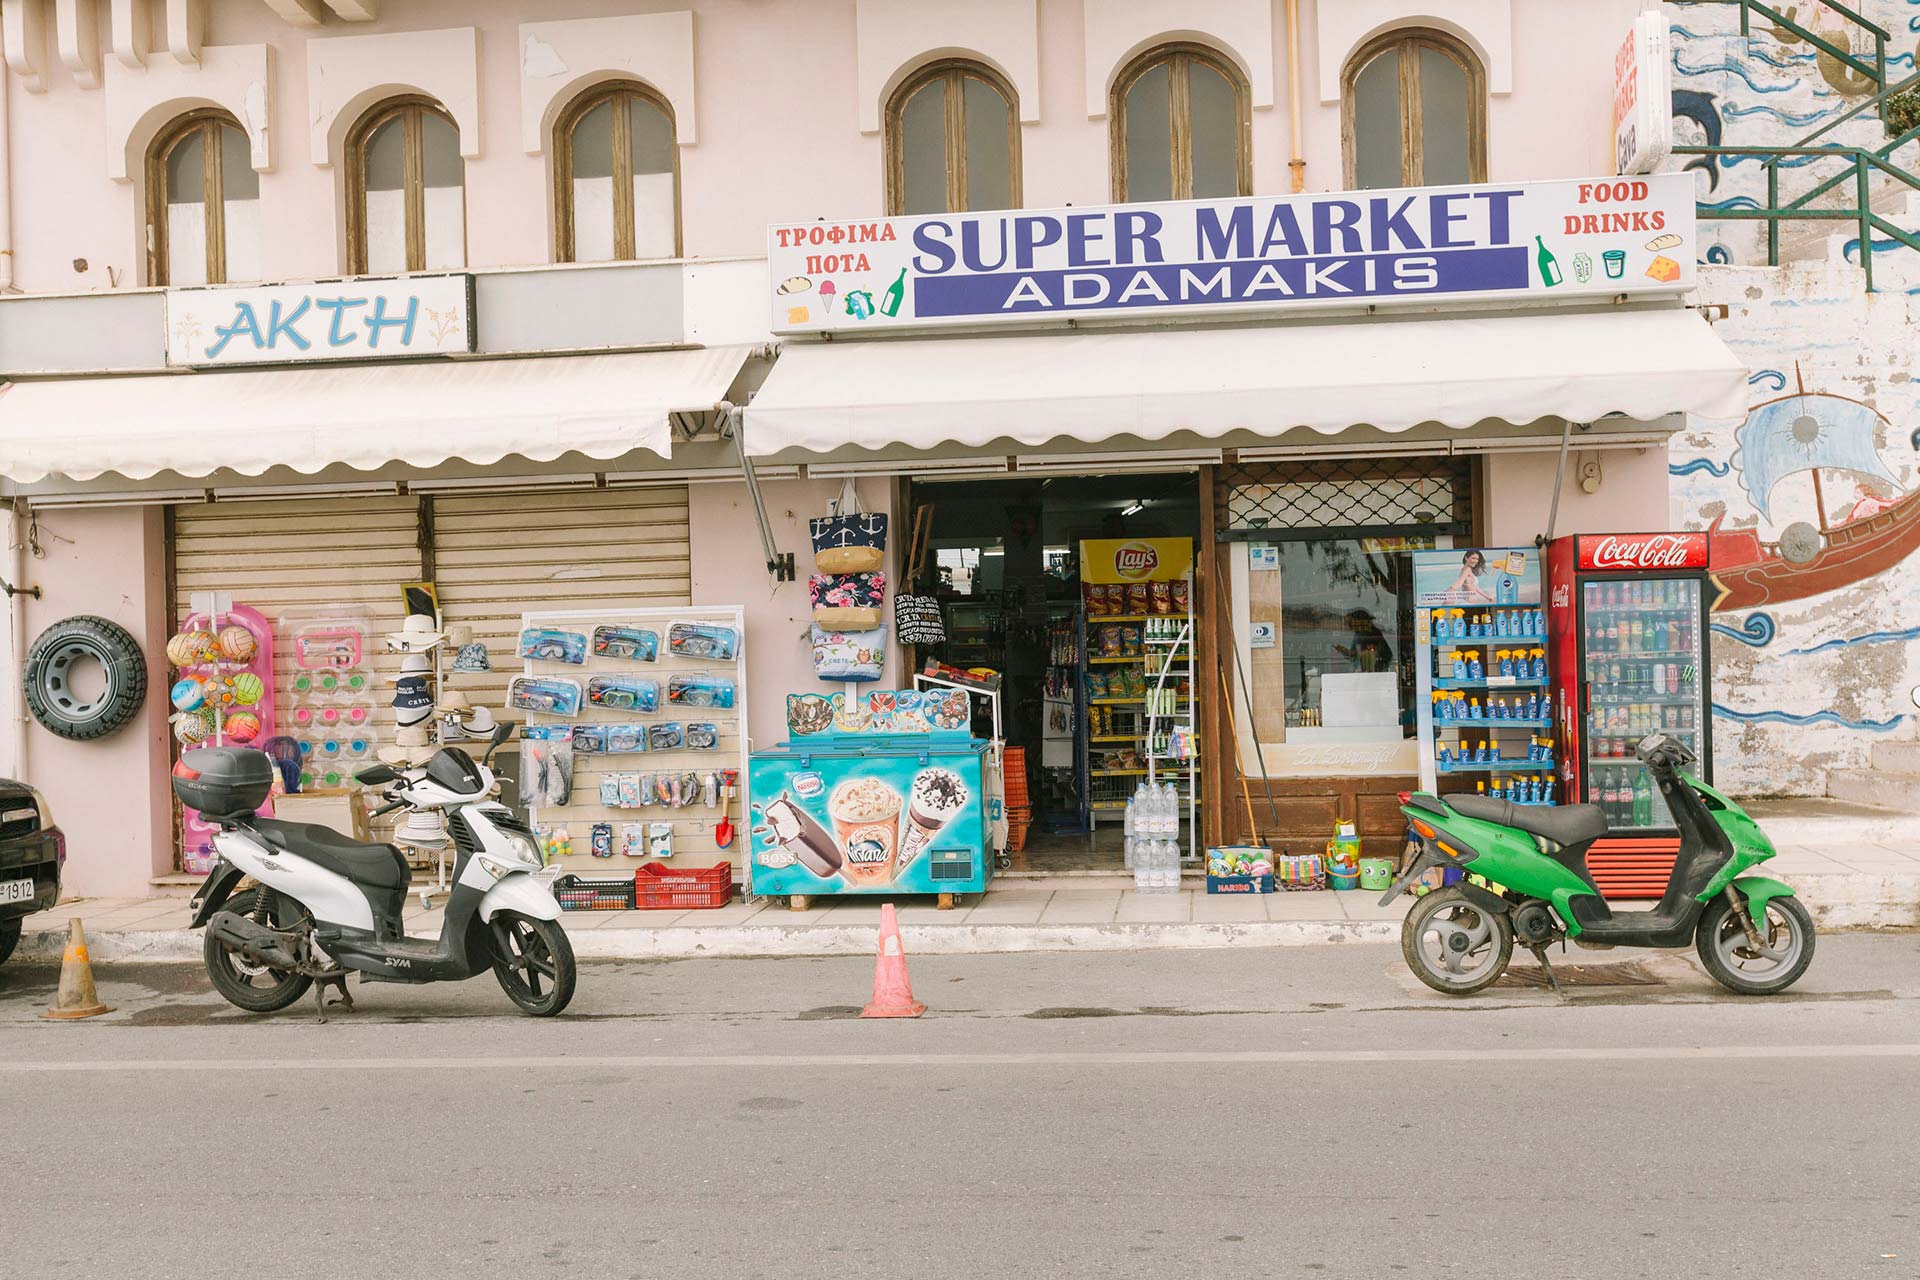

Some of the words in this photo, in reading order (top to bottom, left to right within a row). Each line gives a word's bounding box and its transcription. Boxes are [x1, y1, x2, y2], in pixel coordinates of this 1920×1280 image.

[1577, 181, 1649, 205] FOOD
[776, 222, 897, 248] ΤΡΟΦΙΜΑ
[912, 210, 1164, 274] SUPER
[1196, 189, 1525, 262] MARKET
[1564, 210, 1665, 236] DRINKS
[806, 253, 871, 275] ΠΟΤΑ
[1002, 256, 1440, 309] ADAMAKIS
[204, 295, 421, 359] ΑΚΤΗ
[1118, 550, 1156, 571] Lay's
[761, 852, 796, 865] BOSS
[847, 837, 889, 863] Nirvana
[1217, 884, 1250, 892] HARIBO
[384, 956, 411, 968] SYM
